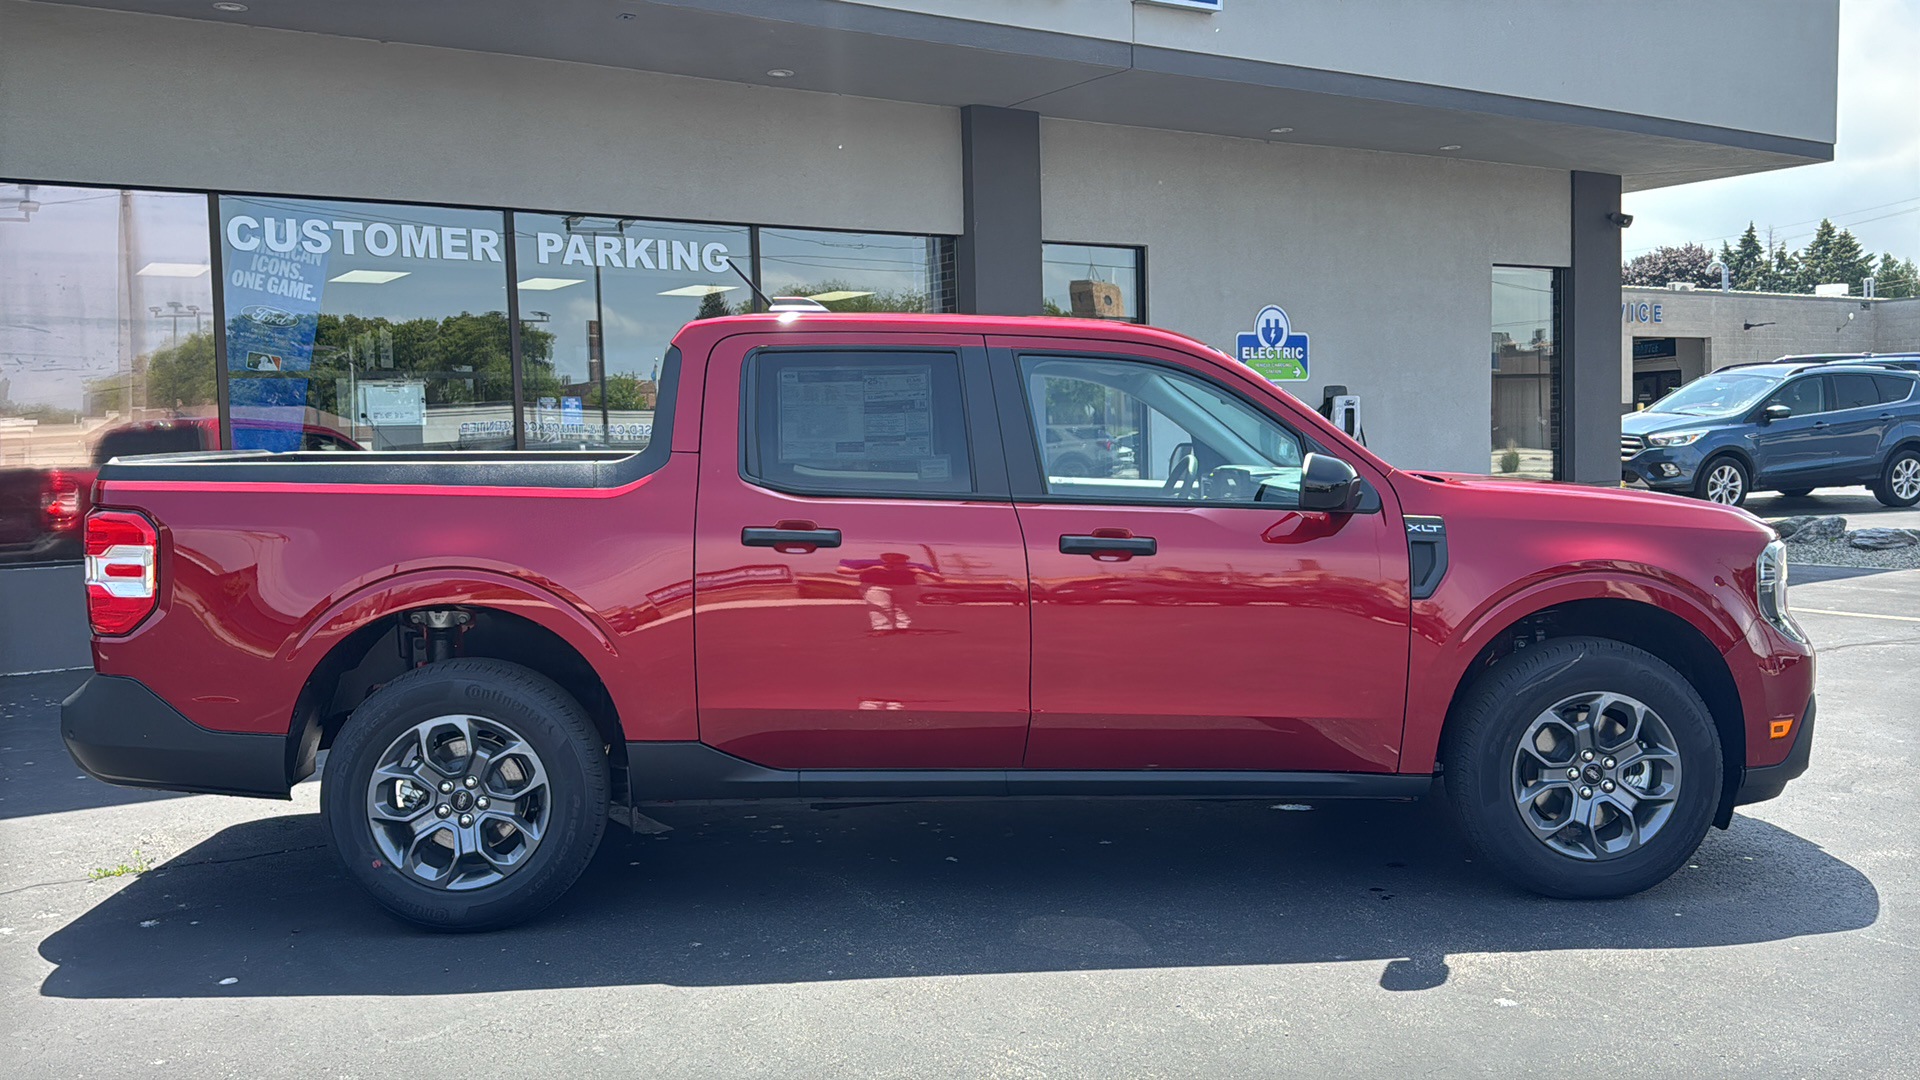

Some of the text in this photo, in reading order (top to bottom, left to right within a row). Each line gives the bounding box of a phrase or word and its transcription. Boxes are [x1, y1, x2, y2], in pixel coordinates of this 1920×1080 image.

[227, 215, 502, 262] CUSTOMER
[537, 233, 730, 273] PARKING
[251, 253, 304, 281] ICONS.
[231, 269, 317, 302] ONE GAME.
[250, 306, 290, 326] Ford
[1241, 346, 1304, 360] ELECTRIC
[1407, 523, 1442, 533] XLT
